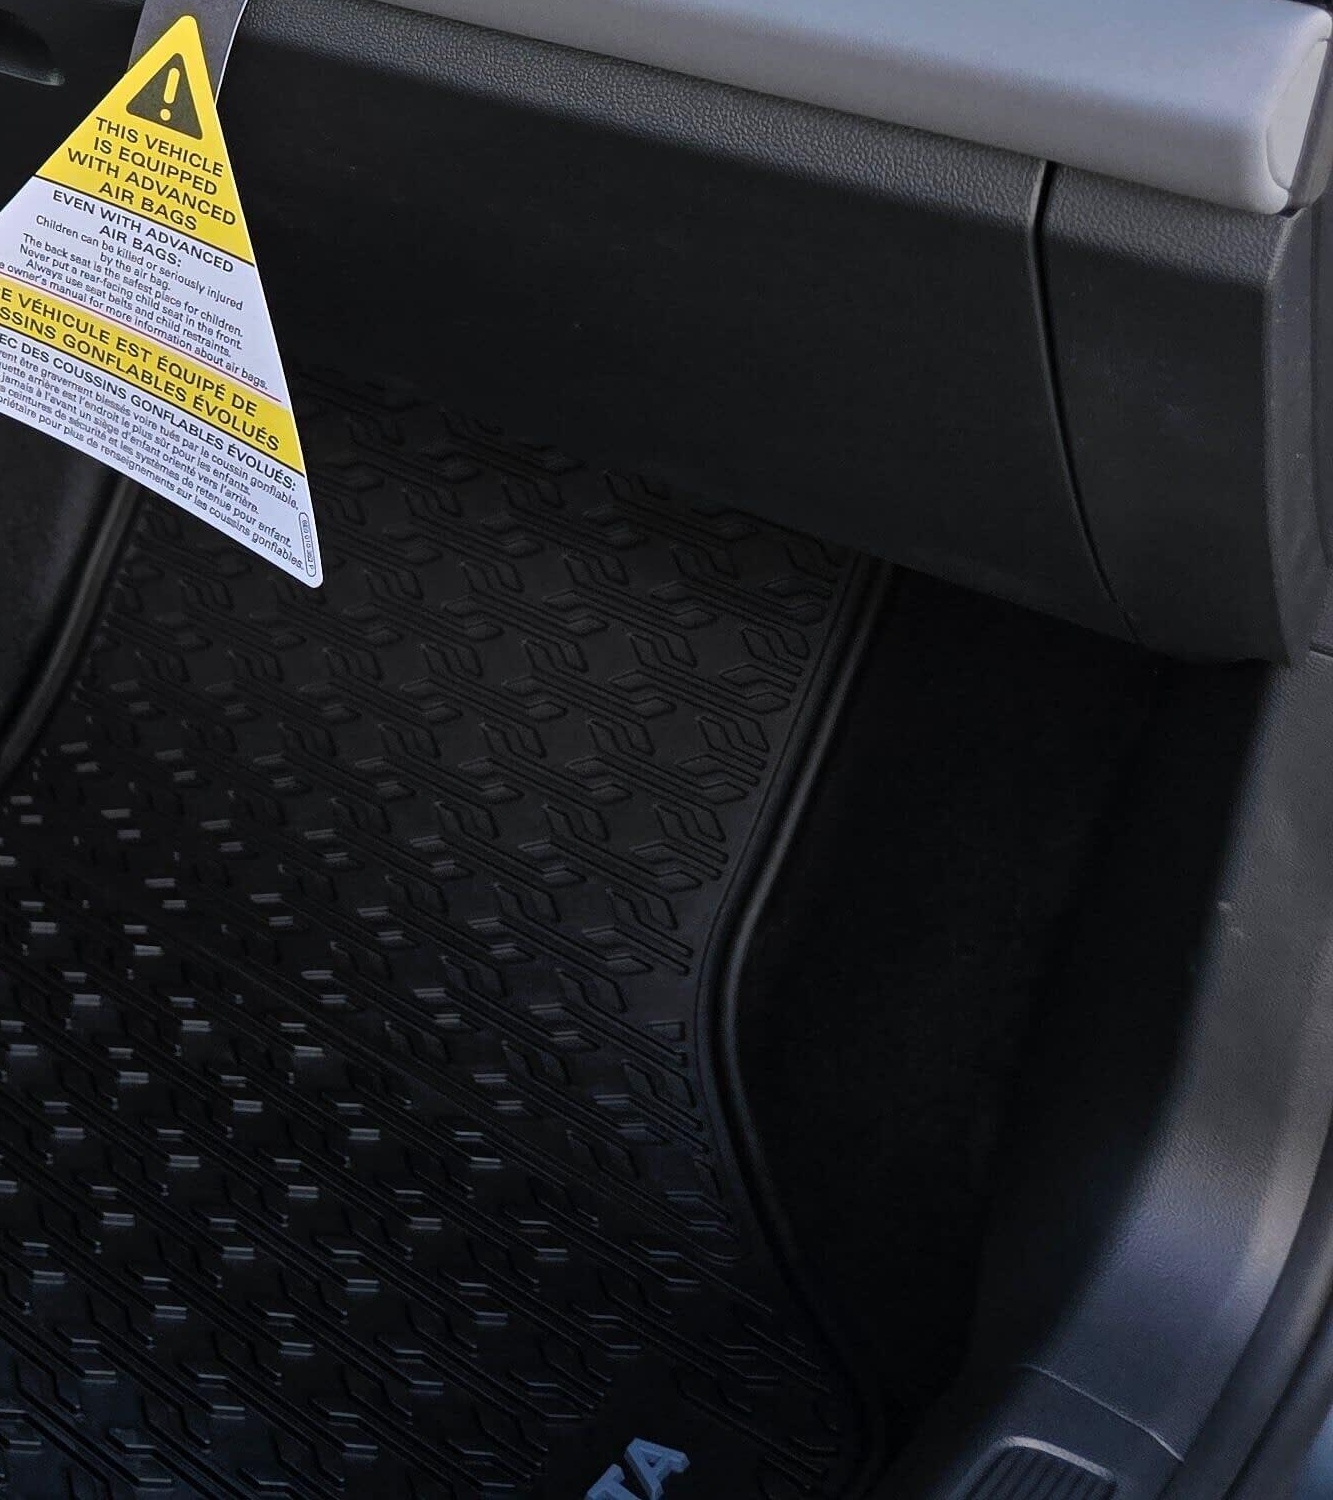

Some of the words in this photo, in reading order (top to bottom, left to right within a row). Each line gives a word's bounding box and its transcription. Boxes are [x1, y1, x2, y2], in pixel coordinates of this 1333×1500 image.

[66, 147, 119, 179] WITH
[125, 170, 237, 226] ADVANCED
[94, 117, 138, 144] THIS
[143, 135, 223, 177] VEHICLE
[94, 137, 112, 155] IS
[119, 146, 217, 197] EQUIPPED
[52, 188, 95, 215] EVEN
[98, 206, 141, 234] WITH
[145, 225, 234, 273] ADVANCED
[99, 180, 134, 206] AIR
[141, 196, 197, 231] BAGS
[99, 223, 127, 244] AIR
[132, 236, 181, 267] BAGS:
[19, 244, 50, 263] Never
[51, 256, 70, 273] put
[71, 266, 77, 274] a
[79, 268, 133, 301] rear-facing
[135, 292, 160, 311] child
[161, 304, 183, 322] seat
[184, 314, 195, 327] in
[196, 320, 213, 336] the
[215, 329, 243, 350] front.
[21, 232, 42, 248] The
[44, 241, 68, 258] back
[69, 252, 91, 268] seat
[93, 261, 102, 273] is
[103, 266, 120, 281] the
[122, 274, 153, 295] safest
[154, 288, 181, 310] place
[183, 301, 199, 316] for
[200, 309, 244, 337] children.
[25, 258, 63, 282] Always
[64, 276, 82, 289] use
[85, 282, 106, 299] seat
[108, 292, 133, 311] belts
[134, 304, 154, 320] and
[155, 313, 180, 333] child
[182, 326, 232, 358] restraints.
[35, 214, 79, 239] Children
[80, 234, 98, 247] can
[101, 241, 114, 253] be
[116, 247, 143, 266] killed
[145, 261, 157, 272] or
[158, 265, 205, 295] seriously
[206, 286, 243, 313] injured
[99, 252, 113, 267] by
[114, 258, 131, 273] the
[133, 266, 147, 280] air
[149, 273, 171, 292] bag.
[6, 262, 47, 286] owner's
[49, 279, 87, 302] manual
[88, 296, 104, 310] for
[105, 305, 131, 323] more
[134, 316, 192, 351] information
[194, 344, 224, 367] about
[225, 360, 240, 375] air
[240, 368, 269, 392] bags.
[16, 290, 111, 345] VÉHICULE
[115, 336, 152, 364] EST
[156, 353, 226, 402] ÉQUIPÉ
[230, 392, 257, 418] DE
[1, 372, 33, 396] jamais
[92, 415, 119, 437] siège
[121, 429, 160, 457] d'enfant
[162, 450, 196, 476] orienté
[196, 472, 217, 490] vers
[19, 357, 38, 372] être
[40, 366, 93, 400] gravement
[132, 410, 157, 430] voire
[159, 424, 180, 442] tués
[181, 438, 198, 454] par
[211, 452, 248, 480] coussin
[250, 474, 299, 512] gonflable.
[21, 342, 49, 363] DES
[52, 356, 127, 400] COUSSINS
[130, 393, 224, 451] GONFLABLES
[227, 441, 296, 492] ÉVOLUÉS:
[27, 372, 60, 394] arrière
[61, 388, 77, 402] est
[78, 396, 119, 423] l'endroit
[130, 422, 153, 442] plus
[154, 434, 171, 450] sûr
[171, 445, 195, 465] pour
[197, 457, 211, 472] les
[212, 465, 252, 495] enfants.
[61, 332, 187, 403] GONFLABLES
[192, 392, 281, 453] ÉVOLUÉS
[38, 415, 61, 433] pour
[62, 424, 84, 444] plus
[100, 443, 175, 492] renseignements
[176, 487, 192, 501] sur
[194, 494, 207, 510] les
[209, 503, 251, 535] coussins
[252, 529, 306, 572] gonflables.
